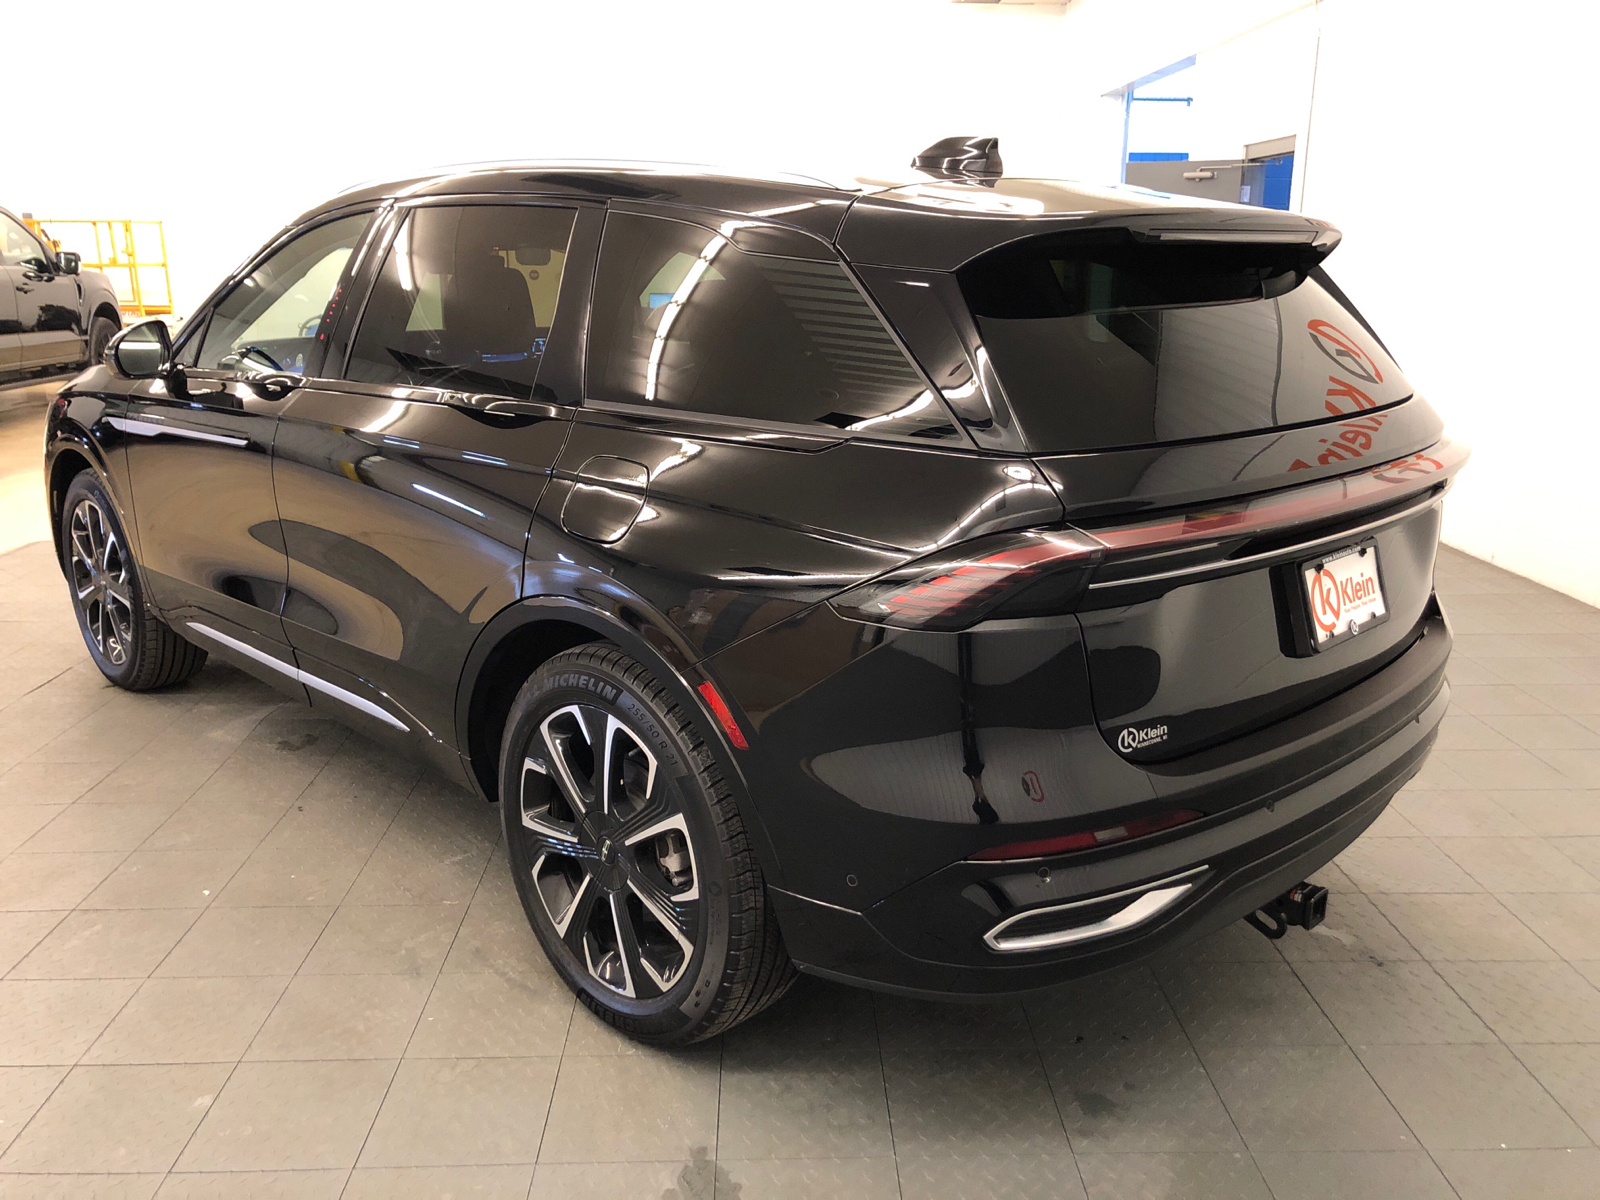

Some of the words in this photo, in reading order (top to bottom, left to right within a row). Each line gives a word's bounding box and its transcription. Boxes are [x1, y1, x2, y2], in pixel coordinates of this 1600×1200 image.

[1340, 572, 1375, 606] Klein
[544, 673, 618, 701] MICHELIN
[627, 703, 660, 739] 255/50
[658, 740, 668, 750] R
[665, 753, 679, 766] 21
[1139, 724, 1168, 741] Klein
